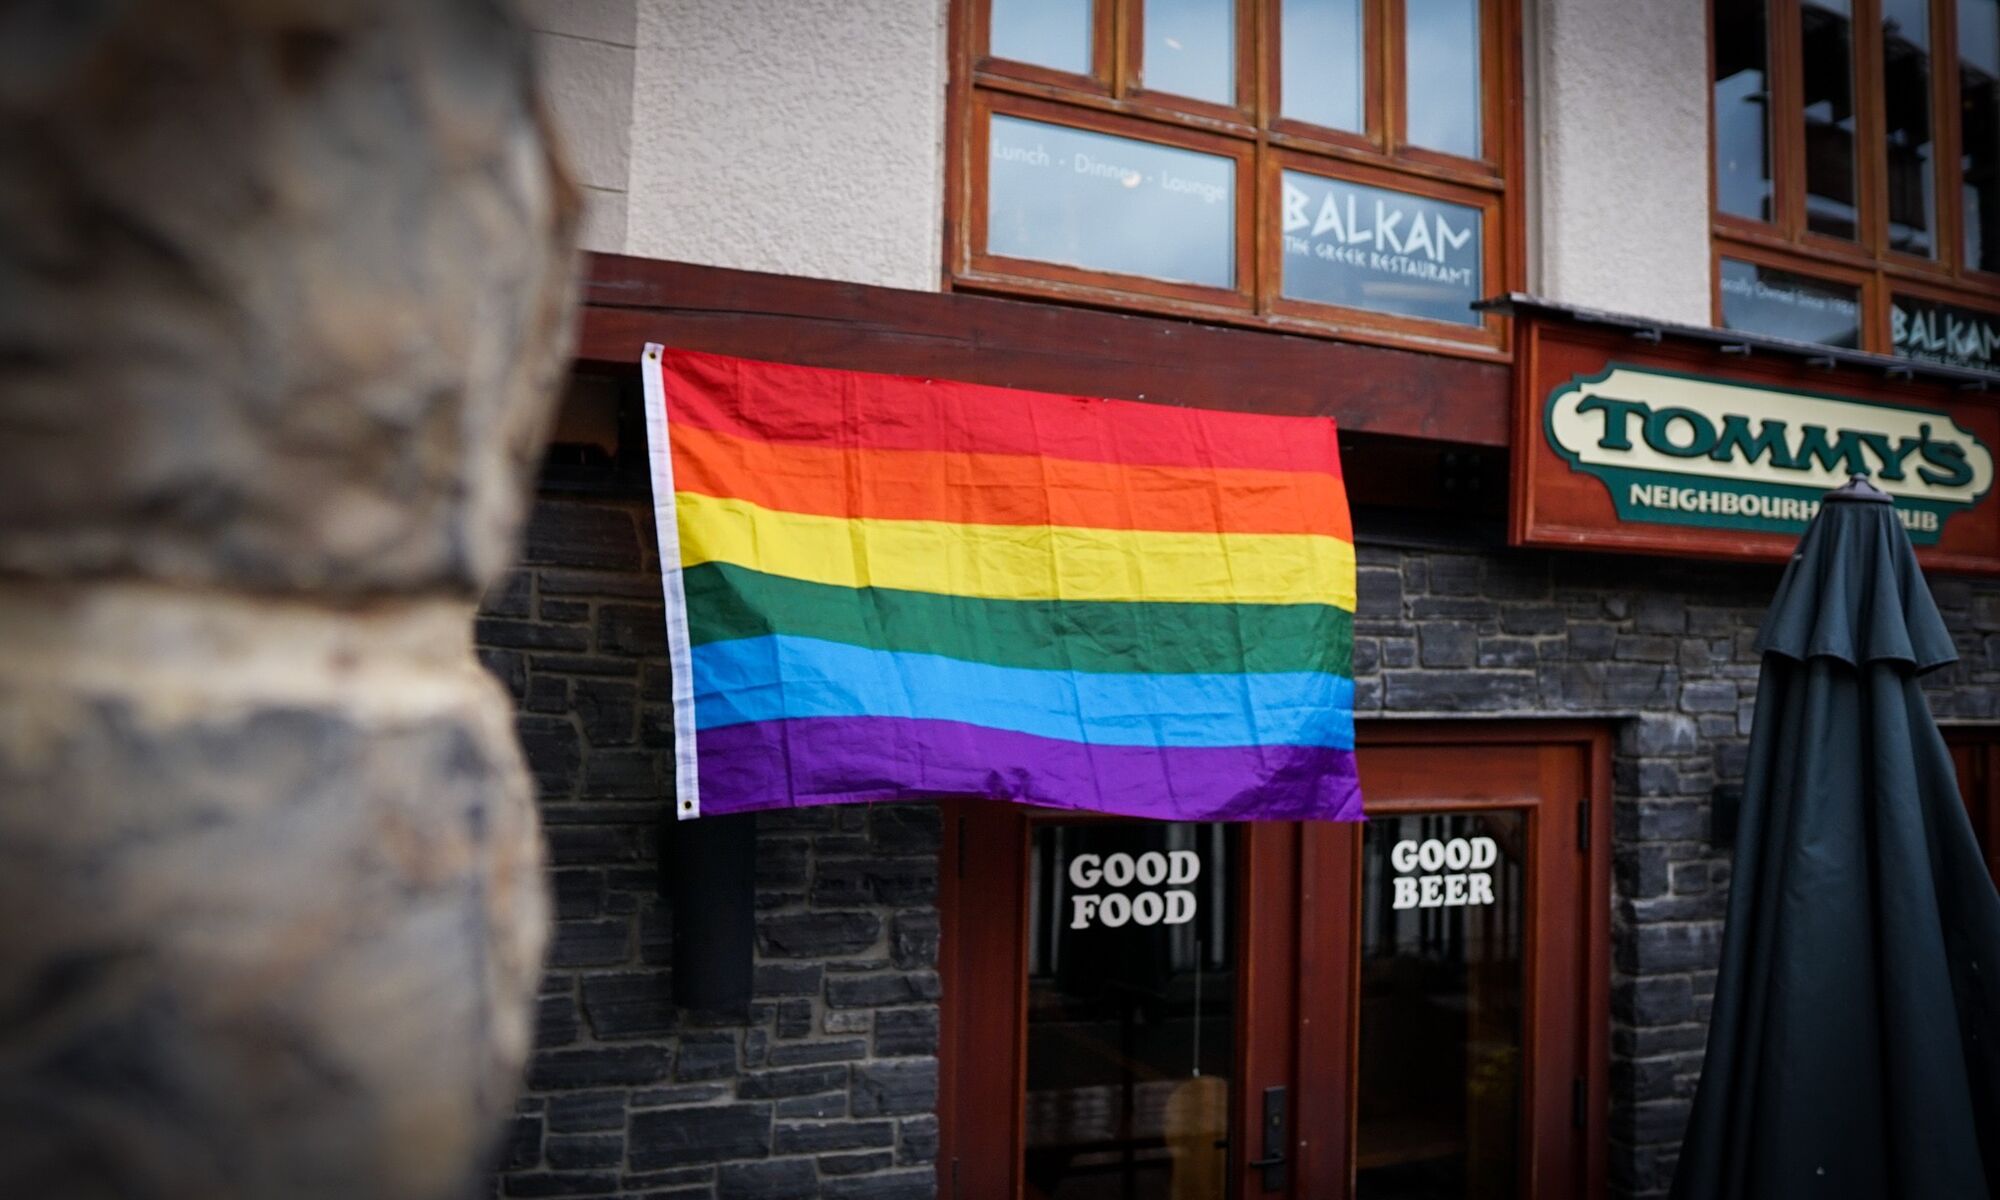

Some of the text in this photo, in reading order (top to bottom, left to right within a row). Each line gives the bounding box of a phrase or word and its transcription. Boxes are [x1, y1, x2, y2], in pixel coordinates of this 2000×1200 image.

[992, 136, 1050, 167] Lunch
[1161, 169, 1227, 203] Lounge
[1282, 182, 1472, 264] BALKAN
[1282, 234, 1472, 287] THE GREEK RESTAURANT
[1576, 394, 1975, 487] TOMMY'S
[1629, 483, 1820, 522] NEIGHBOURH
[1069, 850, 1200, 889] GOOD
[1392, 836, 1498, 873] GOOD
[1069, 889, 1198, 930] FOOD
[1392, 872, 1495, 910] BEER
